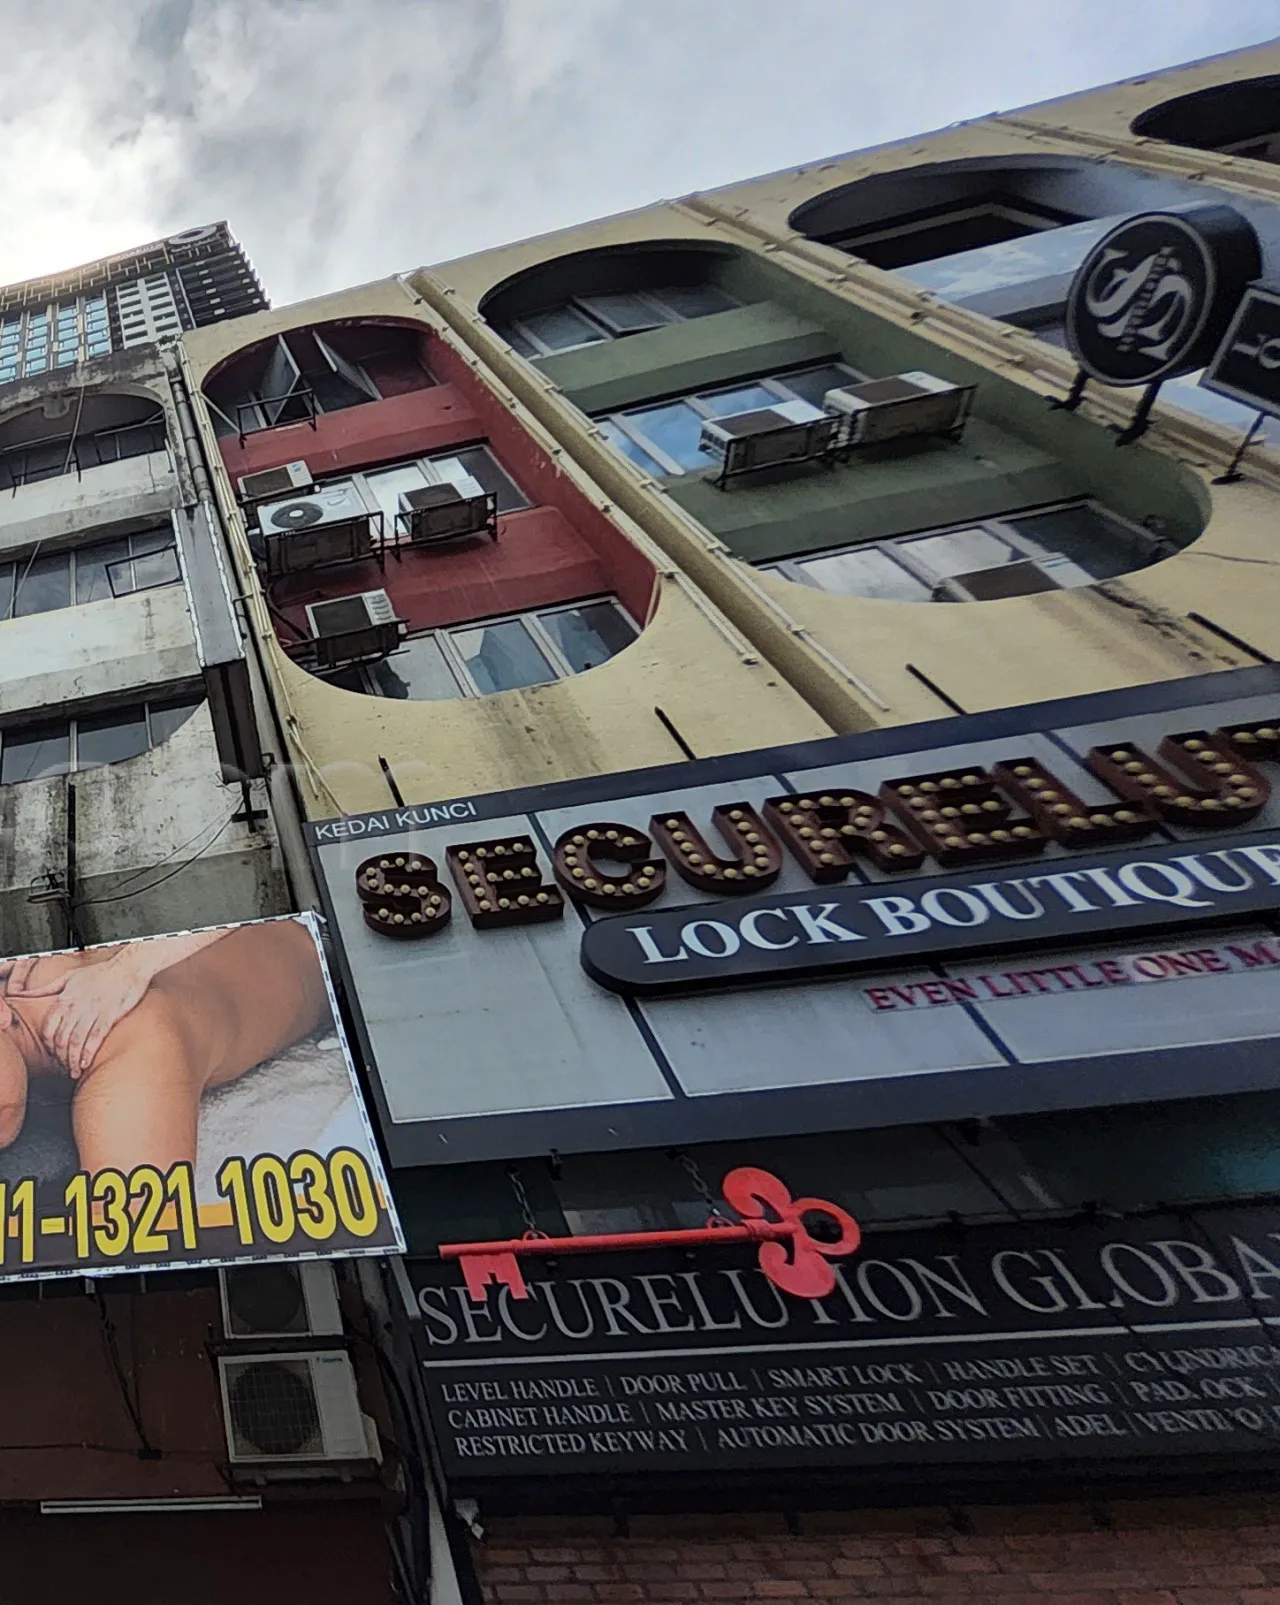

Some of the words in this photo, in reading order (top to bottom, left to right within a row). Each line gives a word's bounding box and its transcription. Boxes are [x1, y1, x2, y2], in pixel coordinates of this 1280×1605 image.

[314, 817, 391, 841] KEDAI
[395, 801, 478, 827] KUNCI
[625, 896, 867, 965] LOCK
[864, 977, 977, 1011] EVEN
[974, 959, 1129, 999] LITTLE
[1131, 948, 1231, 982] ONE
[220, 1148, 380, 1246] 1030
[991, 1232, 1280, 1315] GLOBA
[442, 1380, 508, 1402] LEVEL
[510, 1377, 598, 1401] HANDLE
[619, 1373, 686, 1396] DOOR
[690, 1371, 748, 1393] PULL
[769, 1366, 852, 1389] SMART
[852, 1363, 923, 1384] LOCK
[942, 1358, 1054, 1382] HANDLE
[1050, 1355, 1106, 1376] SET
[448, 1404, 539, 1430] CABINET
[543, 1402, 633, 1426] HANDLE
[656, 1398, 753, 1422] MASTER
[752, 1395, 802, 1419] KEY
[804, 1391, 906, 1416] SYSTEM
[926, 1388, 1009, 1412] DOOR
[1002, 1383, 1112, 1408] FITTING
[455, 1432, 587, 1457] RESTRICTED
[591, 1428, 691, 1453] KEYWAY
[715, 1421, 860, 1449] AUTOMATIC
[859, 1420, 936, 1445] DOOR
[934, 1416, 1043, 1442] SYSTEM
[1052, 1413, 1127, 1438] ADEL
